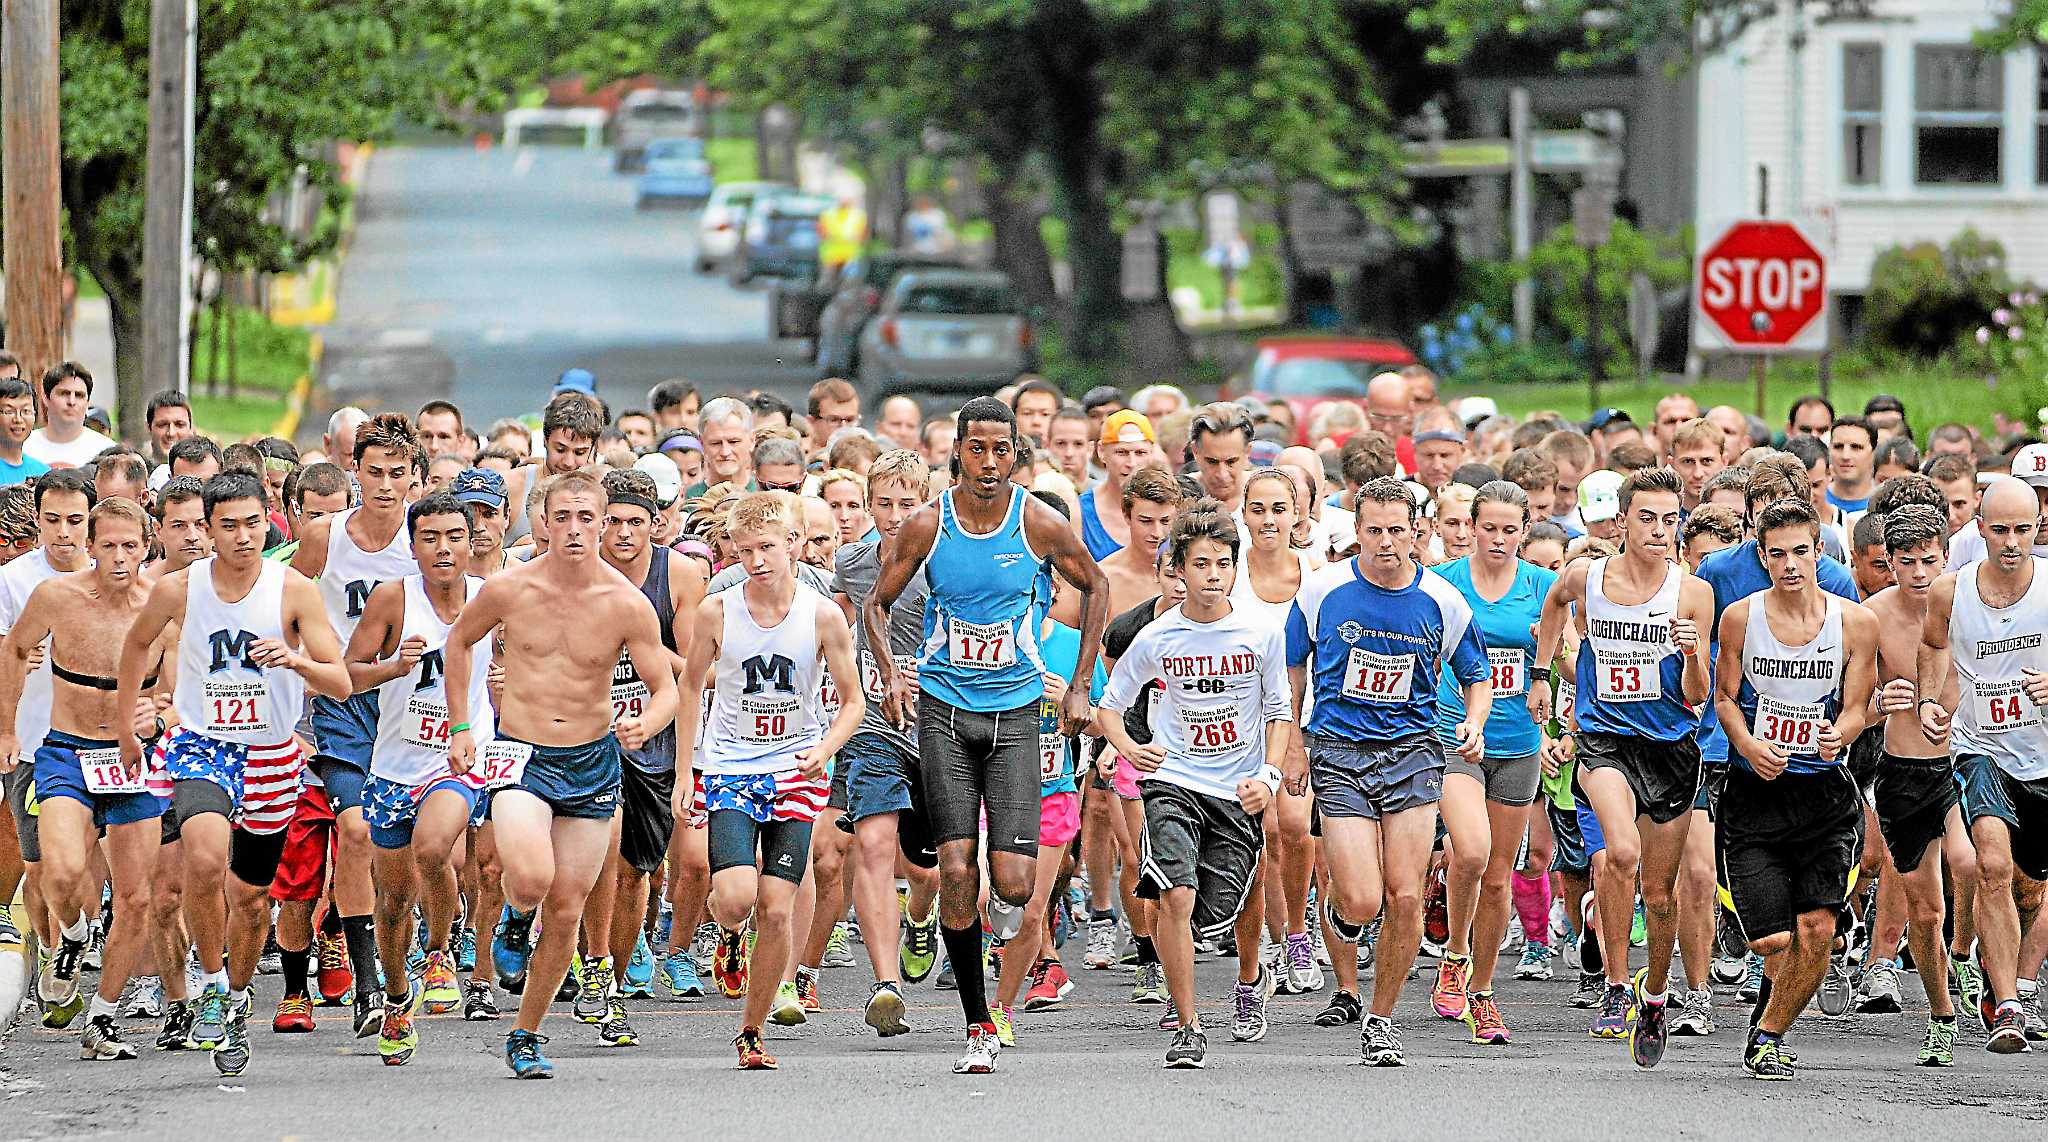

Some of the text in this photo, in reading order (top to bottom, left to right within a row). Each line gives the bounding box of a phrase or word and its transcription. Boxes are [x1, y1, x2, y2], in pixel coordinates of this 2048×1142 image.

[1704, 257, 1820, 310] STOP
[2032, 456, 2046, 472] B
[961, 622, 1005, 633] Citizens Bank
[962, 628, 984, 639] SUMMER
[986, 632, 996, 640] FUN
[1386, 632, 1402, 640] OUR
[1591, 618, 1667, 644] COGINCHAUG
[208, 628, 262, 677] M
[961, 637, 1003, 661] 177
[1604, 650, 1631, 658] Citizens
[1977, 634, 2041, 659] PROVIDENCE
[1162, 653, 1254, 677] PORTLAND
[1362, 654, 1391, 664] Citizens
[1362, 661, 1385, 670] SUMMER
[1752, 657, 1834, 679] COGINCHAUG
[614, 664, 632, 679] 013
[741, 653, 796, 694] M
[1355, 668, 1403, 693] 187
[1610, 667, 1640, 692] 53
[1347, 689, 1376, 698] MIDDLETOWN
[1982, 681, 2010, 690] Citizens
[214, 698, 258, 724] 121
[418, 701, 447, 711] Citizens
[780, 699, 797, 707] Bank
[1216, 705, 1234, 714] Bank
[1770, 700, 1799, 712] Citizens
[1990, 695, 2022, 724] 64
[418, 708, 442, 718] SUMMER
[1770, 708, 1795, 718] SUMMER
[418, 717, 450, 743] 54
[755, 715, 786, 737] 50
[1190, 720, 1237, 747] 268
[1764, 716, 1812, 744] 308
